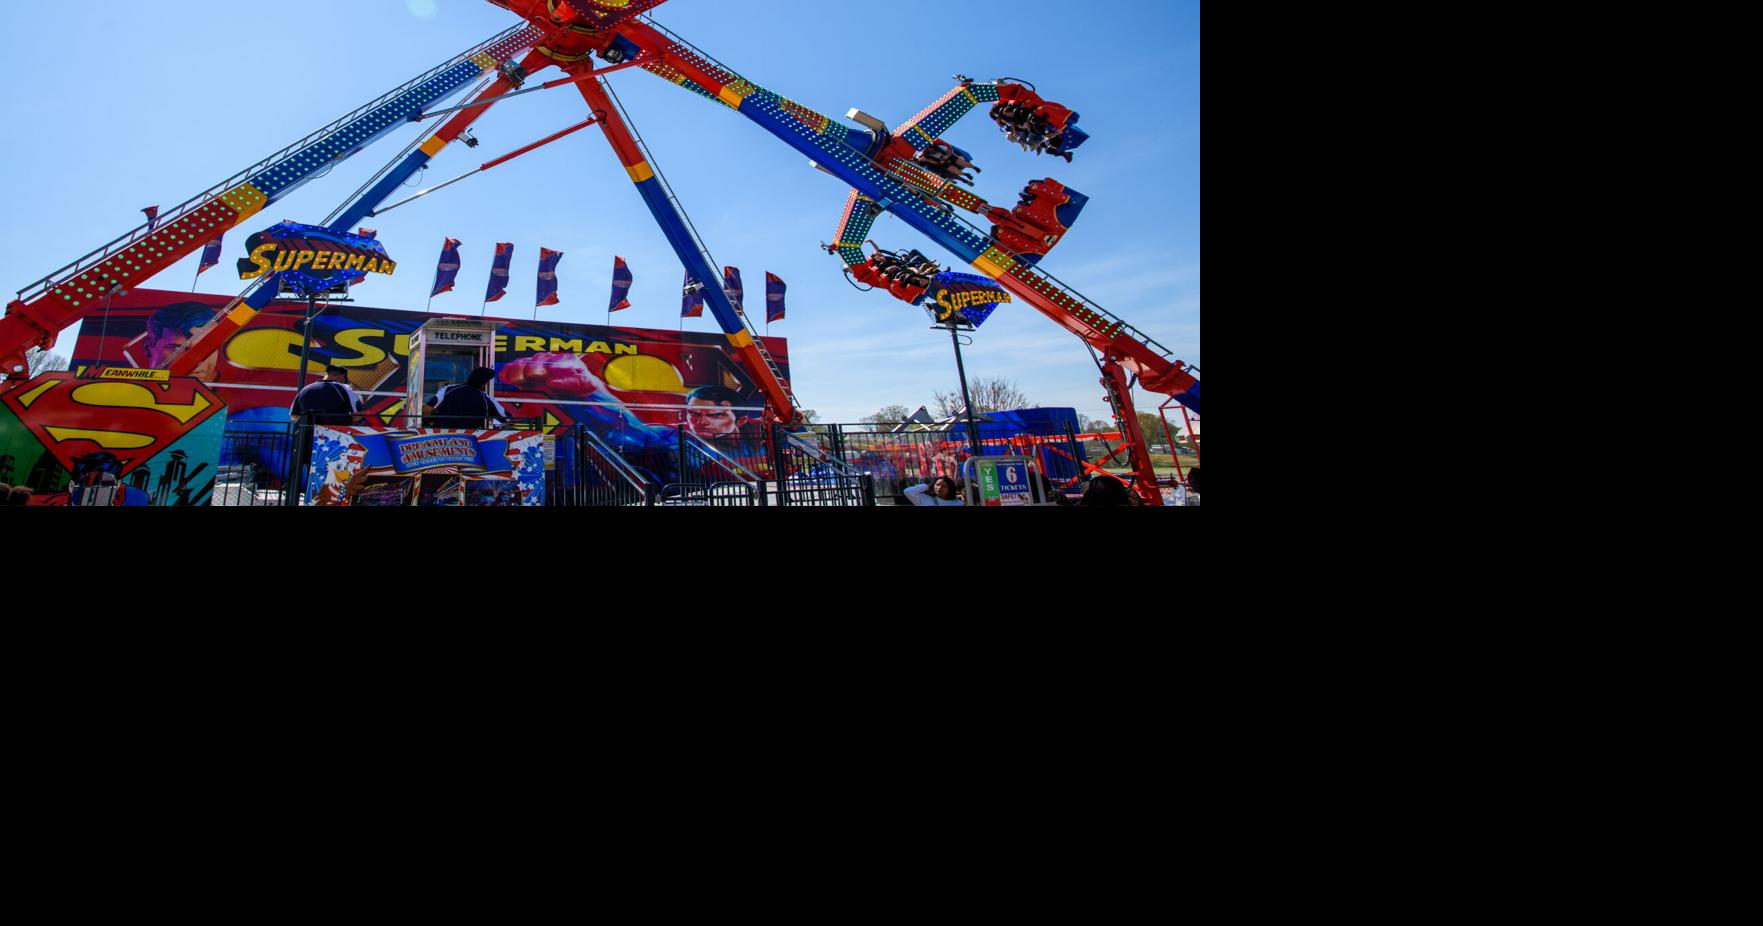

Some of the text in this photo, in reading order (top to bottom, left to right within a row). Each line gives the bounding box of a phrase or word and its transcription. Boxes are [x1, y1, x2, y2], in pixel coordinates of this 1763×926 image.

[240, 243, 397, 280] SUPERMAN
[936, 288, 1012, 320] SUPERMAN
[434, 332, 483, 341] TELEPHONE
[330, 328, 638, 367] SERMAN
[399, 437, 473, 454] DREAMLAND
[401, 447, 477, 464] AMUSEMENTS
[1005, 466, 1018, 483] 6
[1001, 484, 1027, 492] TICKETS
